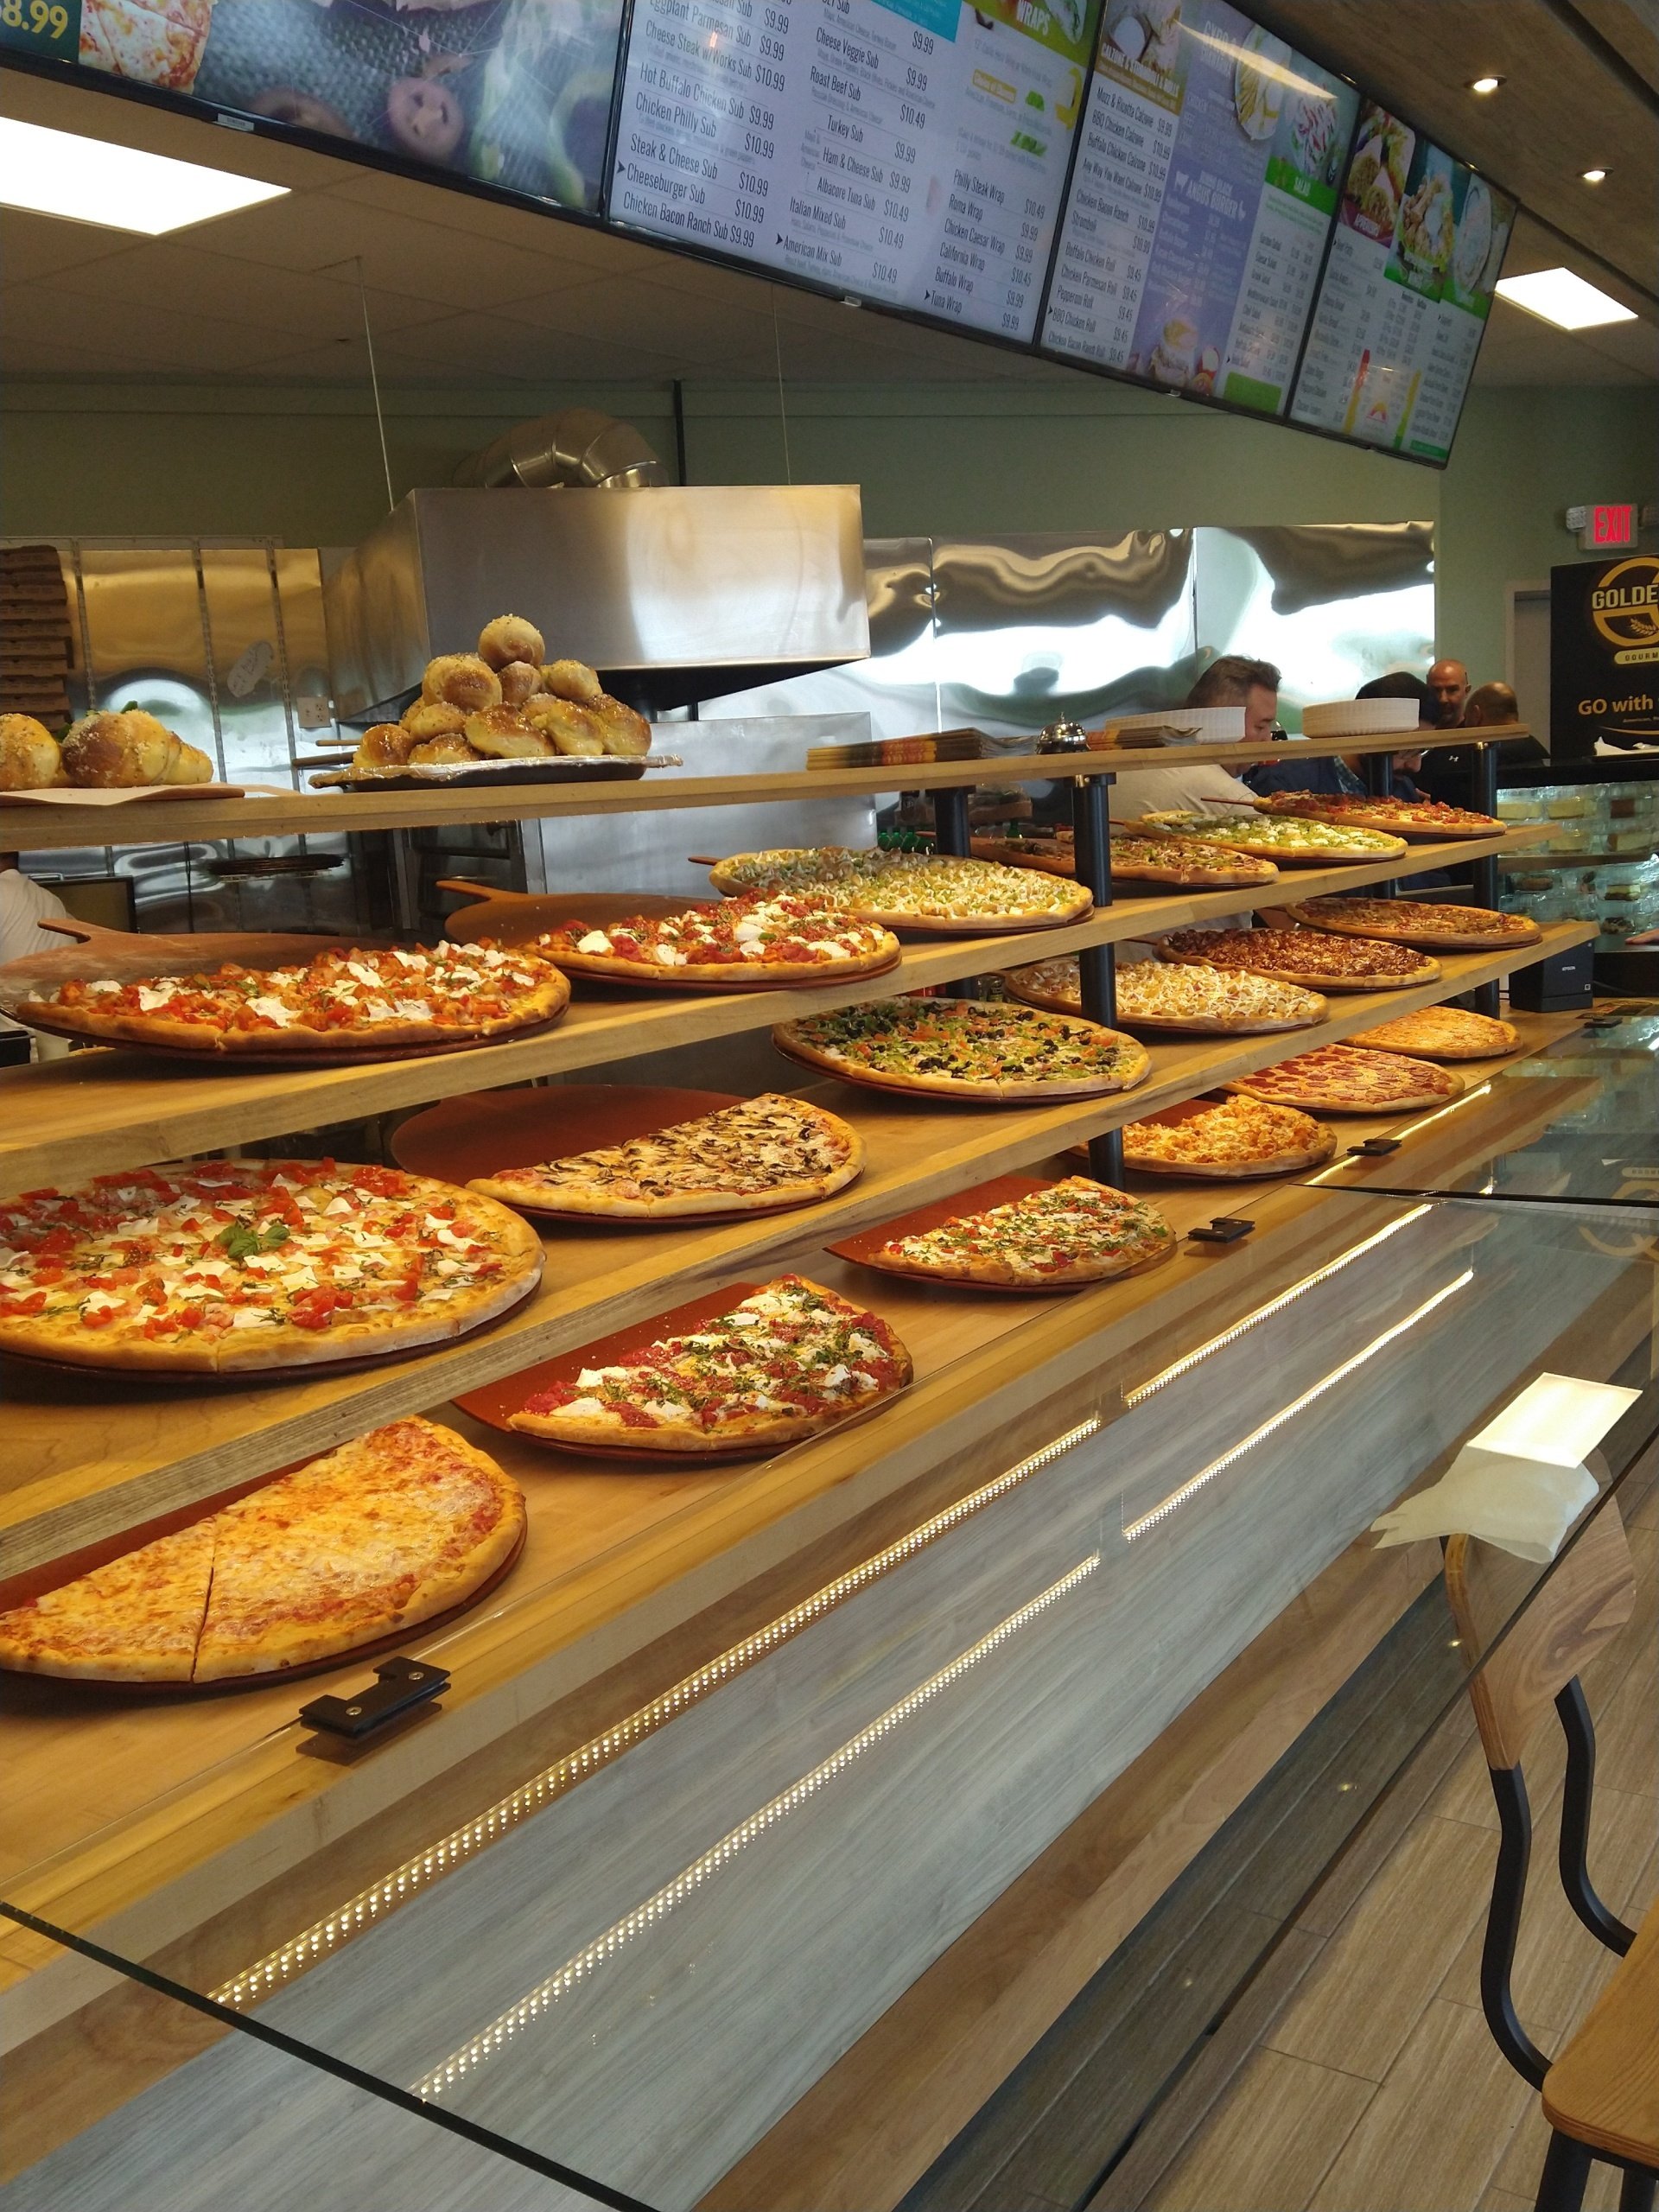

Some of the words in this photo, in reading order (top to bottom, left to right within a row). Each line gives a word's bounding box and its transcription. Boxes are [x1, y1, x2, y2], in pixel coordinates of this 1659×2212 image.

[0, 0, 68, 39] 8.99
[692, 6, 734, 40] Parmesan
[736, 25, 752, 47] Sub
[760, 35, 785, 61] $9.99
[736, 0, 753, 17] Sub
[764, 8, 789, 35] $9.99
[837, 0, 850, 15] Sub
[912, 30, 934, 55] $9.99
[1016, 0, 1050, 35] WRAPS
[645, 20, 676, 47] Cheese
[677, 33, 700, 56] Steak
[702, 46, 736, 73] w/Works
[738, 59, 753, 79] Sub
[755, 65, 785, 92] $10.99
[816, 27, 841, 52] Cheese
[842, 40, 865, 63] Veggie
[866, 50, 880, 69] Sub
[906, 67, 928, 92] $9.99
[640, 62, 657, 84] Hot
[659, 69, 691, 99] Buffalo
[693, 84, 727, 111] Chicken
[728, 98, 744, 119] Sub
[749, 105, 774, 130] $9.99
[810, 66, 830, 86] Roast
[831, 75, 848, 95] Beef
[848, 83, 861, 101] Sub
[899, 104, 925, 130] $10.49
[636, 92, 672, 119] Chicken
[674, 106, 699, 133] Philly
[701, 118, 716, 137] Sub
[745, 132, 774, 159] $10.99
[828, 115, 850, 139] Turkey
[851, 124, 864, 143] Sub
[895, 141, 916, 164] $9.99
[631, 133, 657, 160] Steak
[659, 143, 666, 162] &
[669, 147, 700, 174] Cheese
[702, 159, 718, 180] Sub
[739, 172, 769, 197] $10.99
[823, 146, 839, 165] Ham
[840, 153, 846, 169] &
[847, 156, 870, 178] Cheese
[871, 166, 884, 183] Sub
[889, 171, 911, 194] $9.99
[953, 168, 971, 192] Philly
[971, 176, 989, 196] Steak
[989, 185, 1005, 207] Wrap
[627, 162, 688, 200] Cheeseburger
[690, 184, 706, 205] Sub
[735, 199, 765, 224] $10.99
[817, 176, 846, 201] Albacore
[847, 187, 862, 207] Tuna
[863, 193, 875, 211] Sub
[884, 199, 909, 222] $10.49
[968, 201, 983, 223] Wrap
[624, 191, 658, 219] Chicken
[660, 203, 685, 227] Bacon
[687, 212, 712, 235] Ranch
[714, 220, 728, 240] Sub
[730, 226, 754, 248] $9.99
[790, 196, 811, 218] Italian
[812, 205, 833, 226] Mixed
[833, 213, 846, 230] Sub
[879, 226, 904, 250] $10.49
[944, 218, 969, 240] Chicken
[784, 235, 815, 258] American
[817, 246, 828, 263] Mix
[830, 250, 842, 267] Sub
[872, 262, 898, 284] $10.49
[1594, 505, 1631, 543] EXIT
[1592, 584, 1659, 610] GOLDE
[1625, 652, 1659, 662] GOURM
[1578, 698, 1607, 715] GO
[1611, 694, 1654, 712] with
